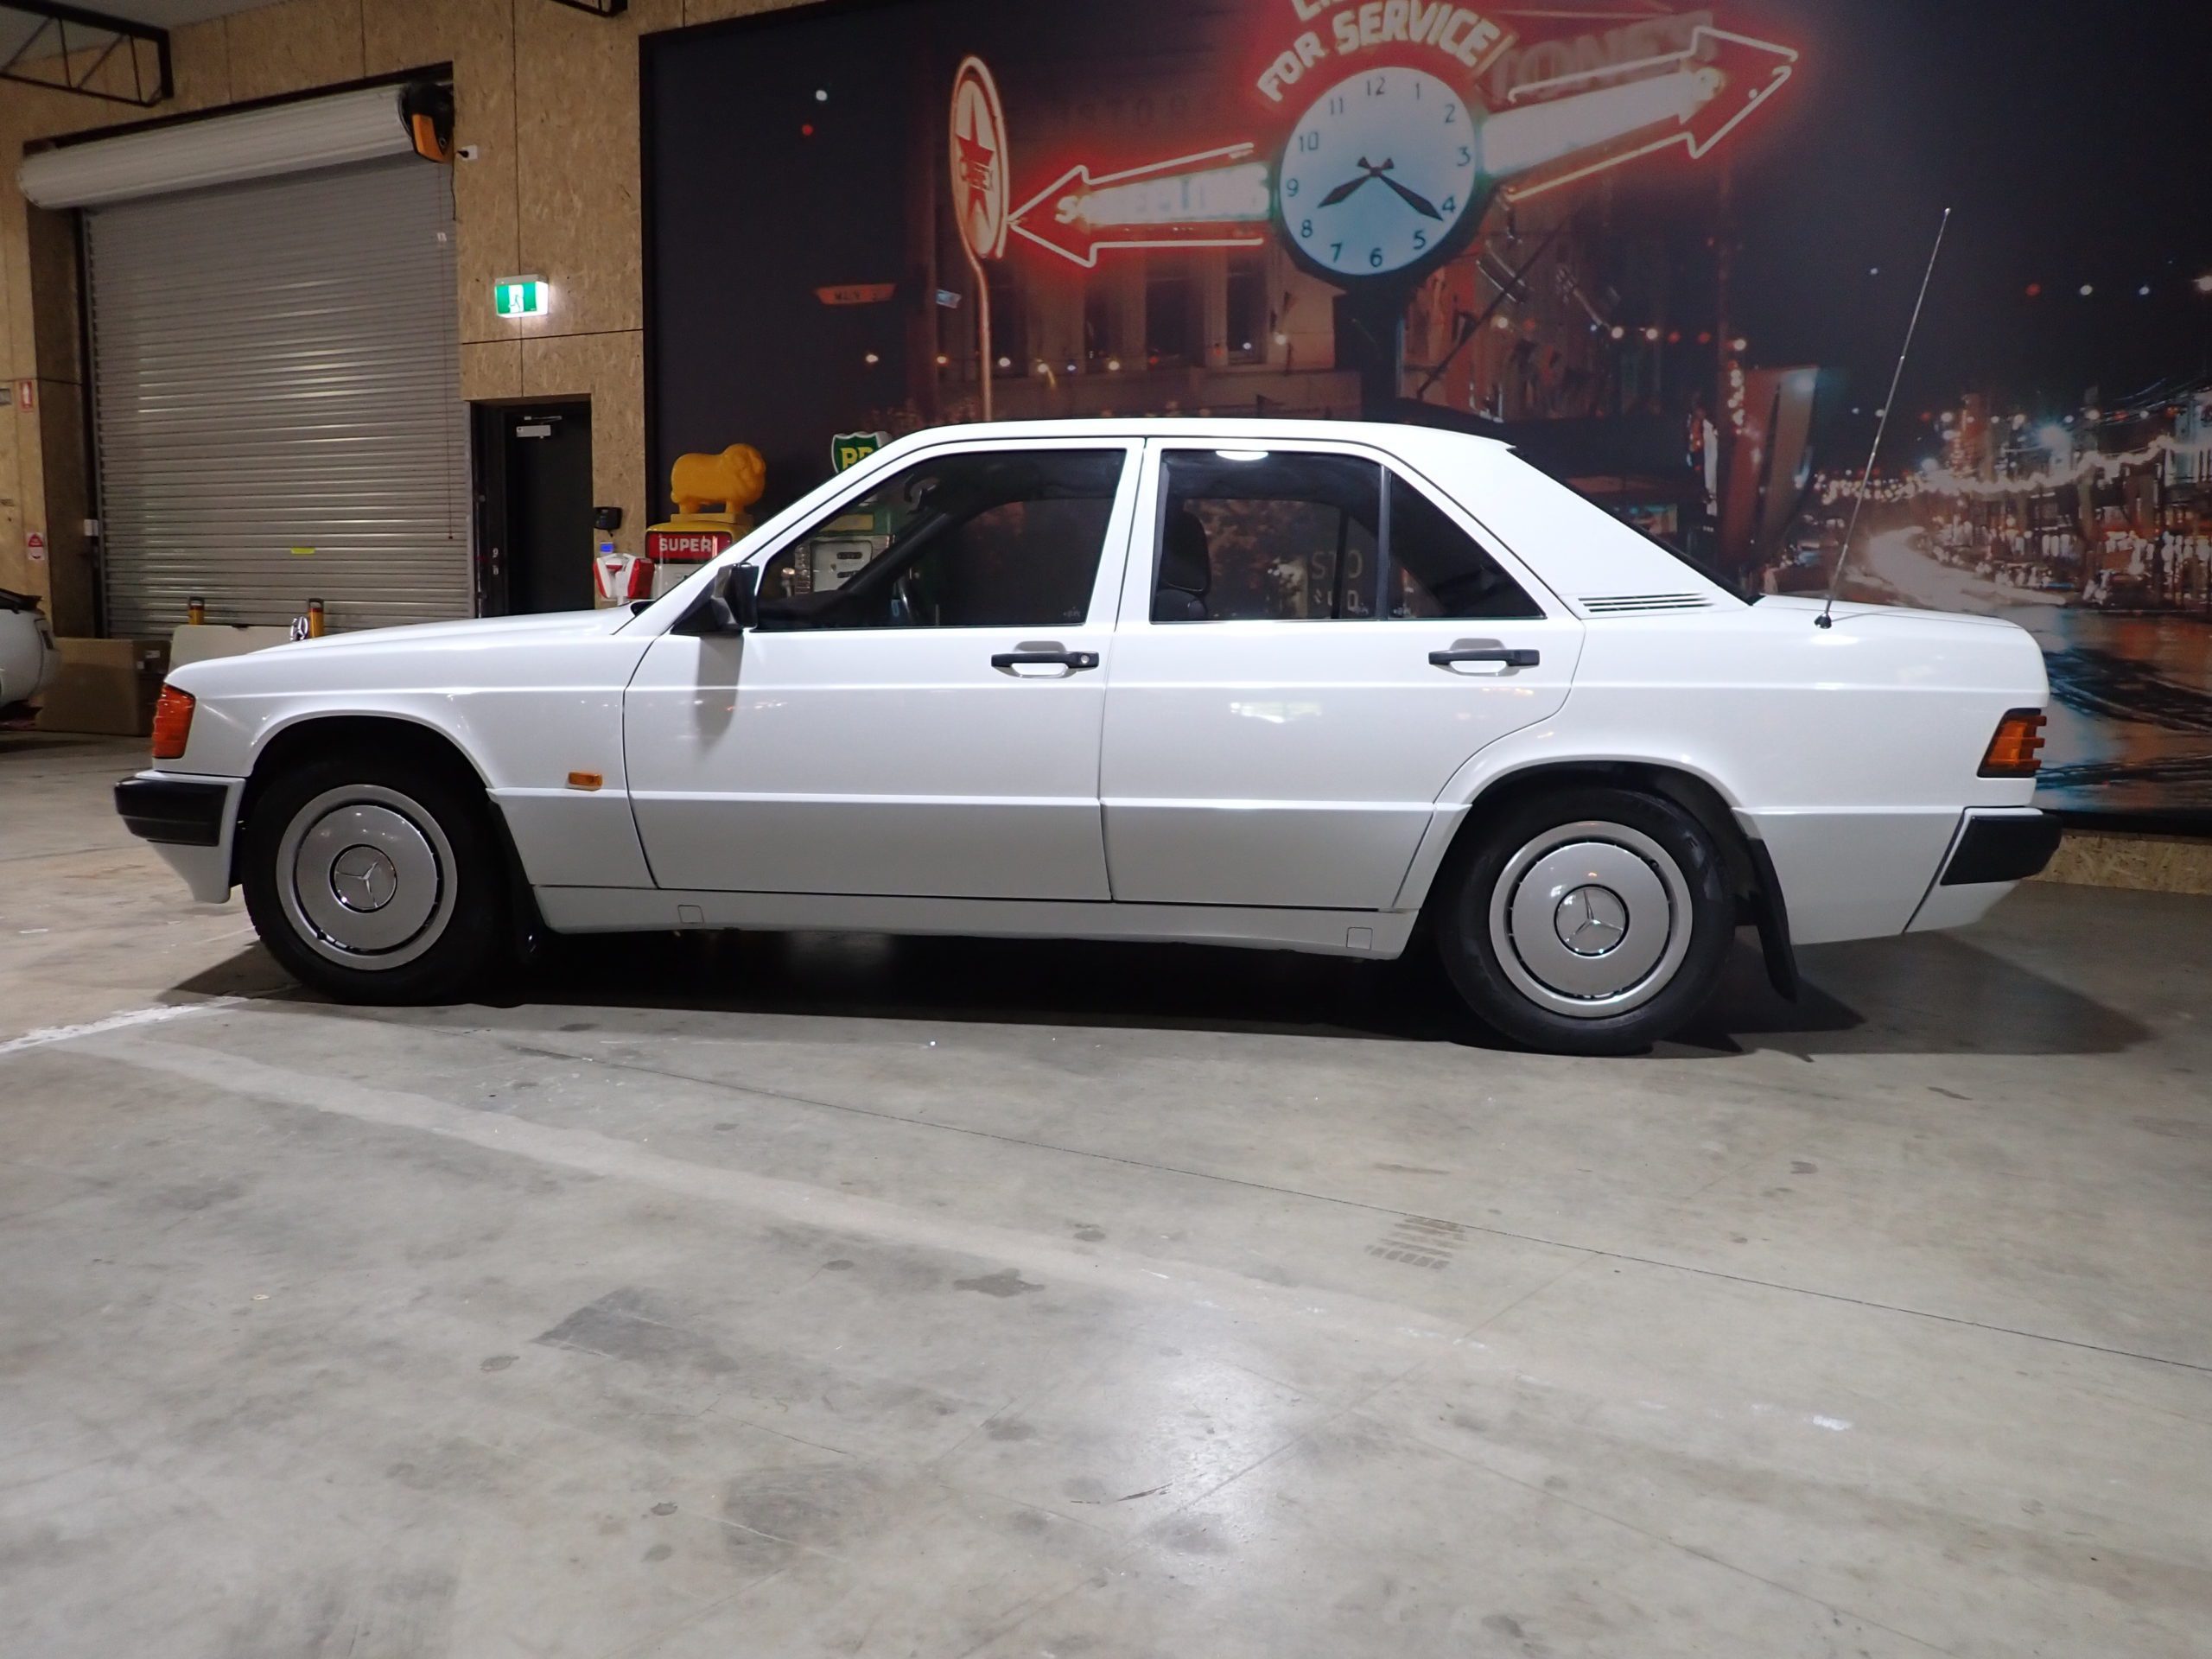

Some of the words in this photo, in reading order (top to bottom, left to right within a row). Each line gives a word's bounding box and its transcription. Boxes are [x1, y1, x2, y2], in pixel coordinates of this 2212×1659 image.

[1257, 31, 1327, 102] FOR
[1332, 1, 1501, 67] SERVICE
[1366, 75, 1386, 97] 12
[1414, 82, 1421, 100] 1
[1330, 97, 1344, 116] 11
[1445, 104, 1456, 124] 2
[1299, 131, 1319, 153] 10
[1457, 146, 1471, 168] 3
[1286, 178, 1300, 198] 9
[1441, 195, 1457, 214] 4
[1300, 219, 1313, 238] 8
[1413, 230, 1427, 251] 5
[1330, 242, 1343, 264] 7
[1369, 247, 1383, 269] 6
[659, 537, 712, 552] SUPER
